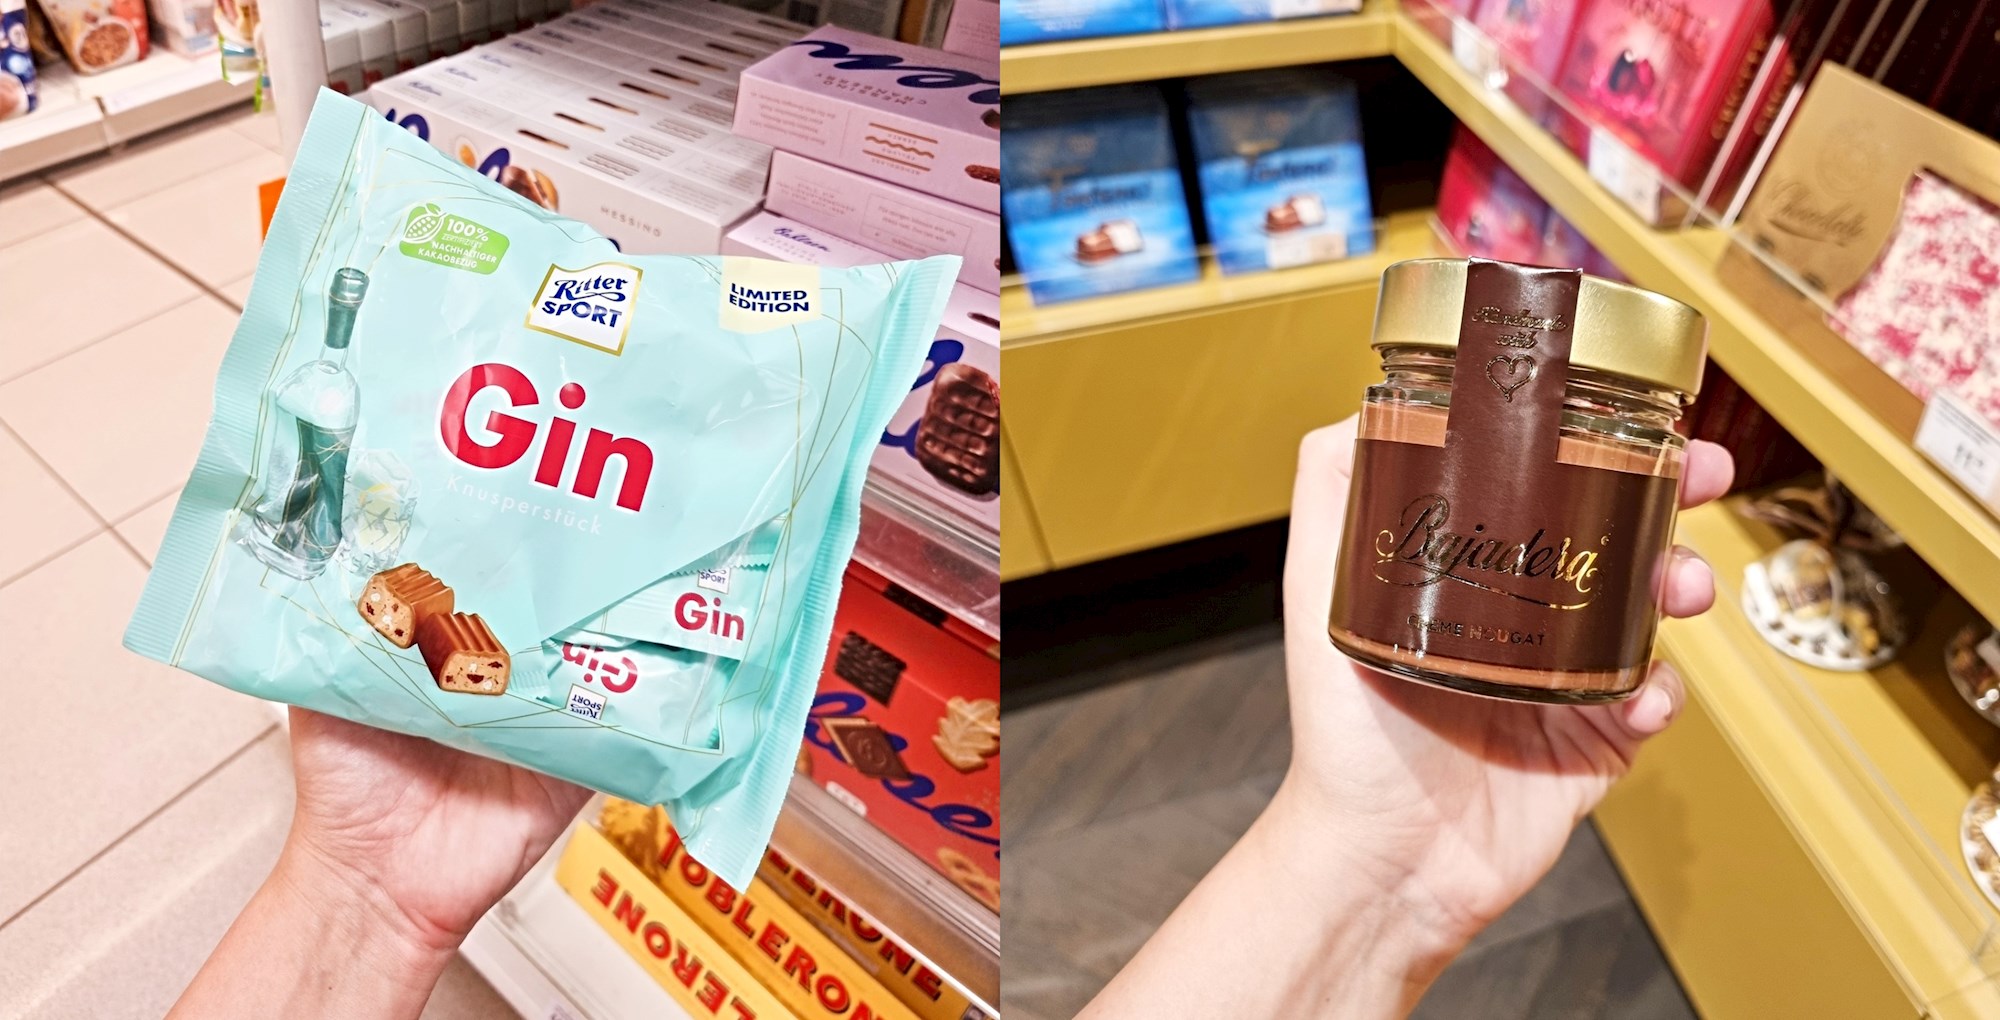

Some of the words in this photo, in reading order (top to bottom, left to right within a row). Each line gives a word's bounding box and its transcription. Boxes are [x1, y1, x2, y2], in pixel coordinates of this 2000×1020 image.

[446, 218, 490, 242] 100%
[599, 206, 663, 238] MESSINO
[417, 247, 478, 269] KAKAOBEZUG
[431, 240, 498, 263] NACHHALTIGER
[548, 274, 628, 303] Ritter
[730, 282, 808, 301] LIMITED
[541, 300, 623, 328] SPORT
[728, 292, 810, 313] EDITION
[1495, 330, 1538, 349] with
[440, 362, 655, 513] Gin
[446, 474, 603, 536] Knusperstück
[1371, 492, 1603, 610] Bajadera
[700, 571, 727, 585] SPORT
[673, 591, 745, 642] Gin
[1469, 623, 1546, 647] NOUGAT
[561, 641, 639, 694] Gin
[571, 693, 603, 711] SPORT
